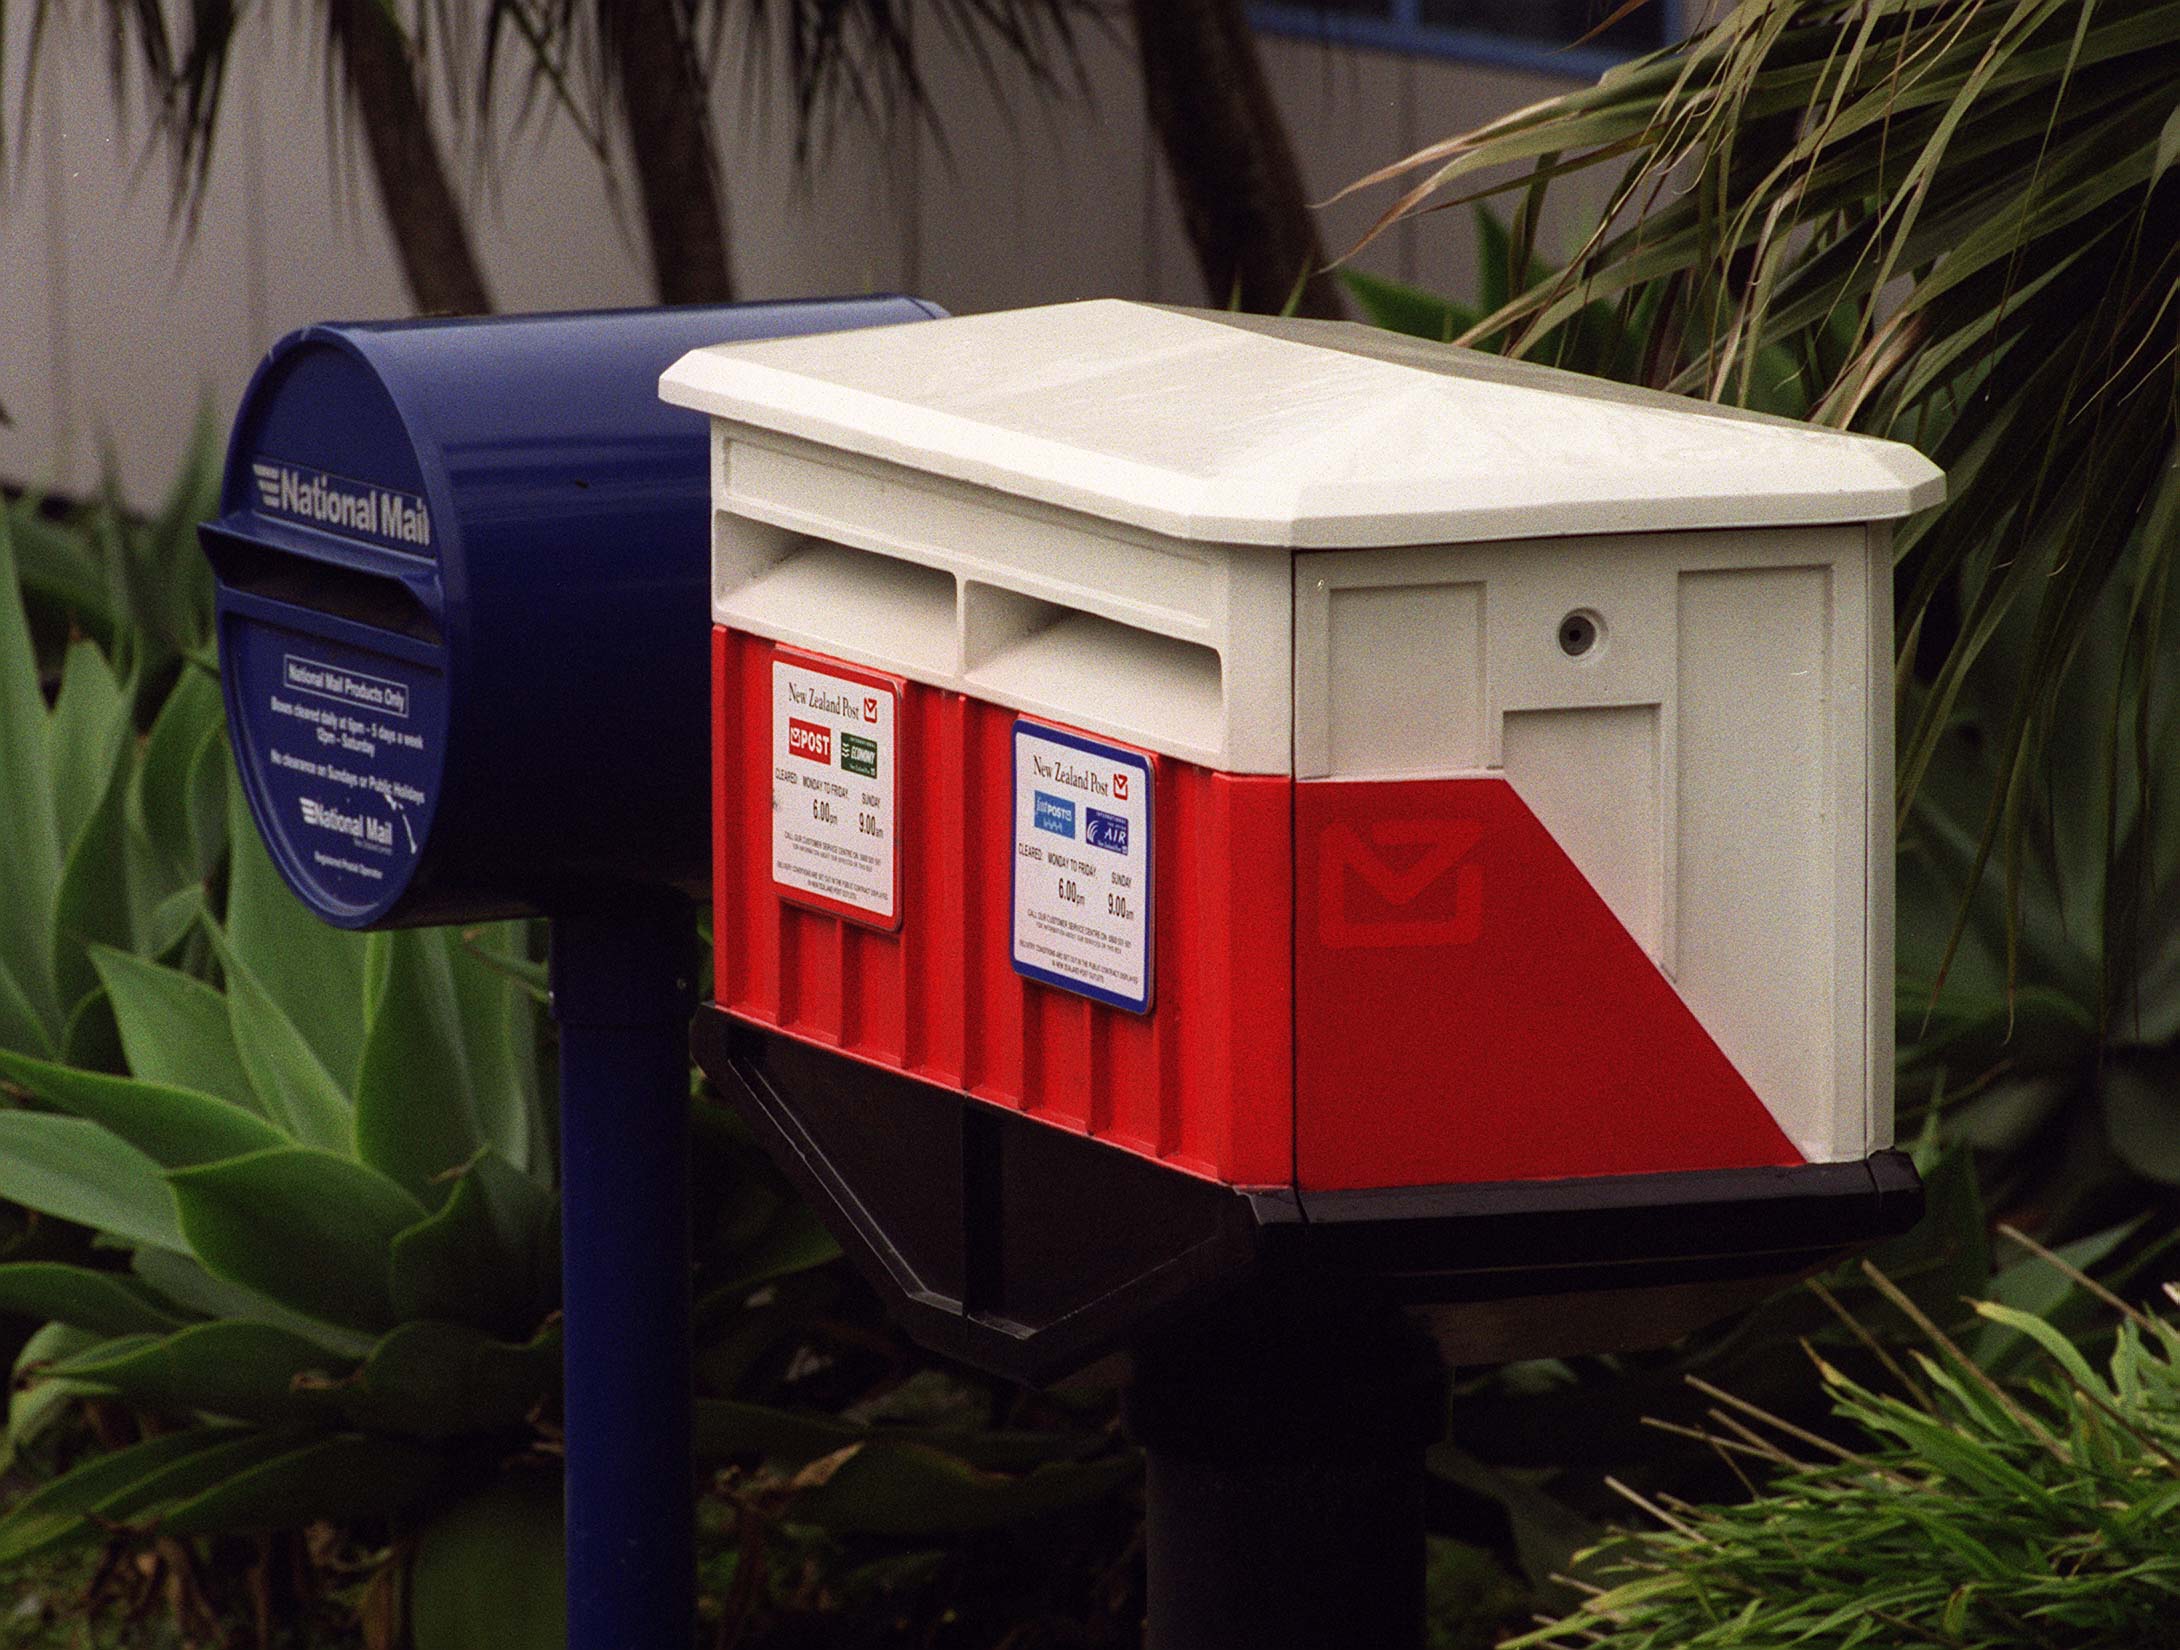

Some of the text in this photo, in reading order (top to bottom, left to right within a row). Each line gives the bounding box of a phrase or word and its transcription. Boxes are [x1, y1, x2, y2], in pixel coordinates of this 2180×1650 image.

[280, 469, 430, 546] National Mail
[289, 663, 404, 712] National Mail Products Only
[788, 682, 859, 720] New Zealand Post
[801, 729, 829, 756] POST
[851, 746, 876, 765] ECONOMY
[802, 775, 822, 792] MONDAY
[824, 781, 831, 794] TO
[862, 792, 880, 808] SUNDAY
[1033, 754, 1109, 796] New Zealand Post
[315, 803, 393, 846] National Mail
[1104, 828, 1126, 845] AIR
[1048, 852, 1069, 868] MONDAY
[1070, 858, 1078, 872] TO
[1111, 872, 1132, 888] SUNDAY
